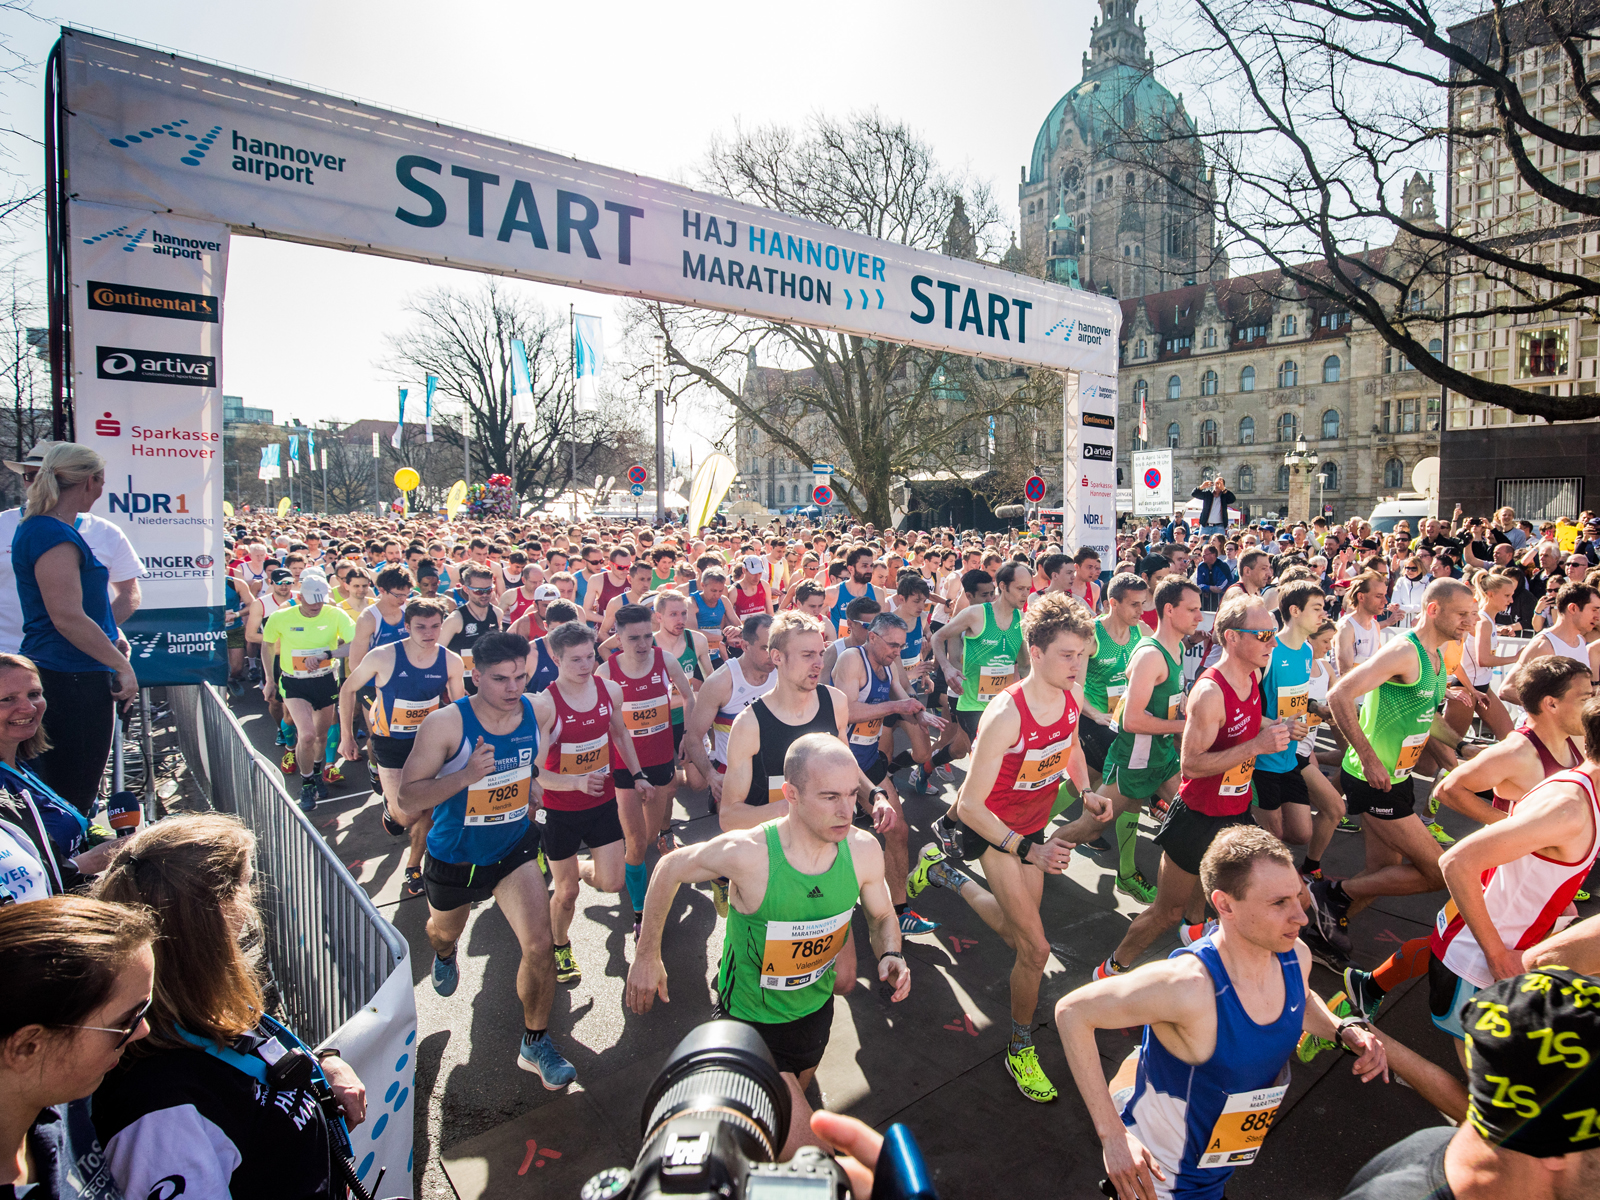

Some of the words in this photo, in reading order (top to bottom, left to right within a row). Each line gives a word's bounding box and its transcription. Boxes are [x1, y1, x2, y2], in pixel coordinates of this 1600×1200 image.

[232, 130, 346, 171] hannover
[232, 155, 314, 185] airport
[395, 154, 644, 265] START
[153, 229, 221, 252] hannover
[682, 209, 737, 248] HAJ
[749, 226, 886, 282] HANNOVER
[153, 243, 203, 261] airport
[682, 250, 832, 306] MARATHON
[93, 287, 197, 313] Continental
[909, 274, 1032, 344] START
[1077, 319, 1112, 338] hannover
[1077, 330, 1102, 346] airport
[141, 358, 209, 375] artiva
[131, 426, 219, 443] Sparkasse
[131, 444, 216, 459] Hannover
[1094, 447, 1112, 456] artiva
[1090, 481, 1113, 489] Sparkasse
[108, 486, 172, 517] NDR
[1090, 490, 1112, 498] Hannover
[137, 516, 215, 525] Niedersachsen
[1083, 513, 1099, 525] NDR
[168, 641, 216, 655] airport
[990, 676, 1008, 686] 7271
[405, 708, 430, 719] 9825
[632, 708, 657, 721] 8423
[1048, 731, 1061, 740] LGO
[575, 749, 601, 765] 8427
[1037, 752, 1062, 772] 8425
[487, 778, 510, 787] MARATHON
[497, 770, 518, 780] HANNOVER
[487, 783, 519, 803] 7926
[492, 802, 512, 811] Hendrik
[805, 918, 837, 930] HANNOVER
[791, 928, 825, 938] MARATHON
[791, 935, 834, 959] 7862
[766, 962, 775, 972] A
[795, 958, 823, 971] Valentin
[798, 975, 810, 984] GLS
[1527, 1027, 1590, 1069] ZS
[1252, 1093, 1266, 1101] HAJ
[1485, 1074, 1541, 1119] ZS
[1211, 1138, 1220, 1149] A
